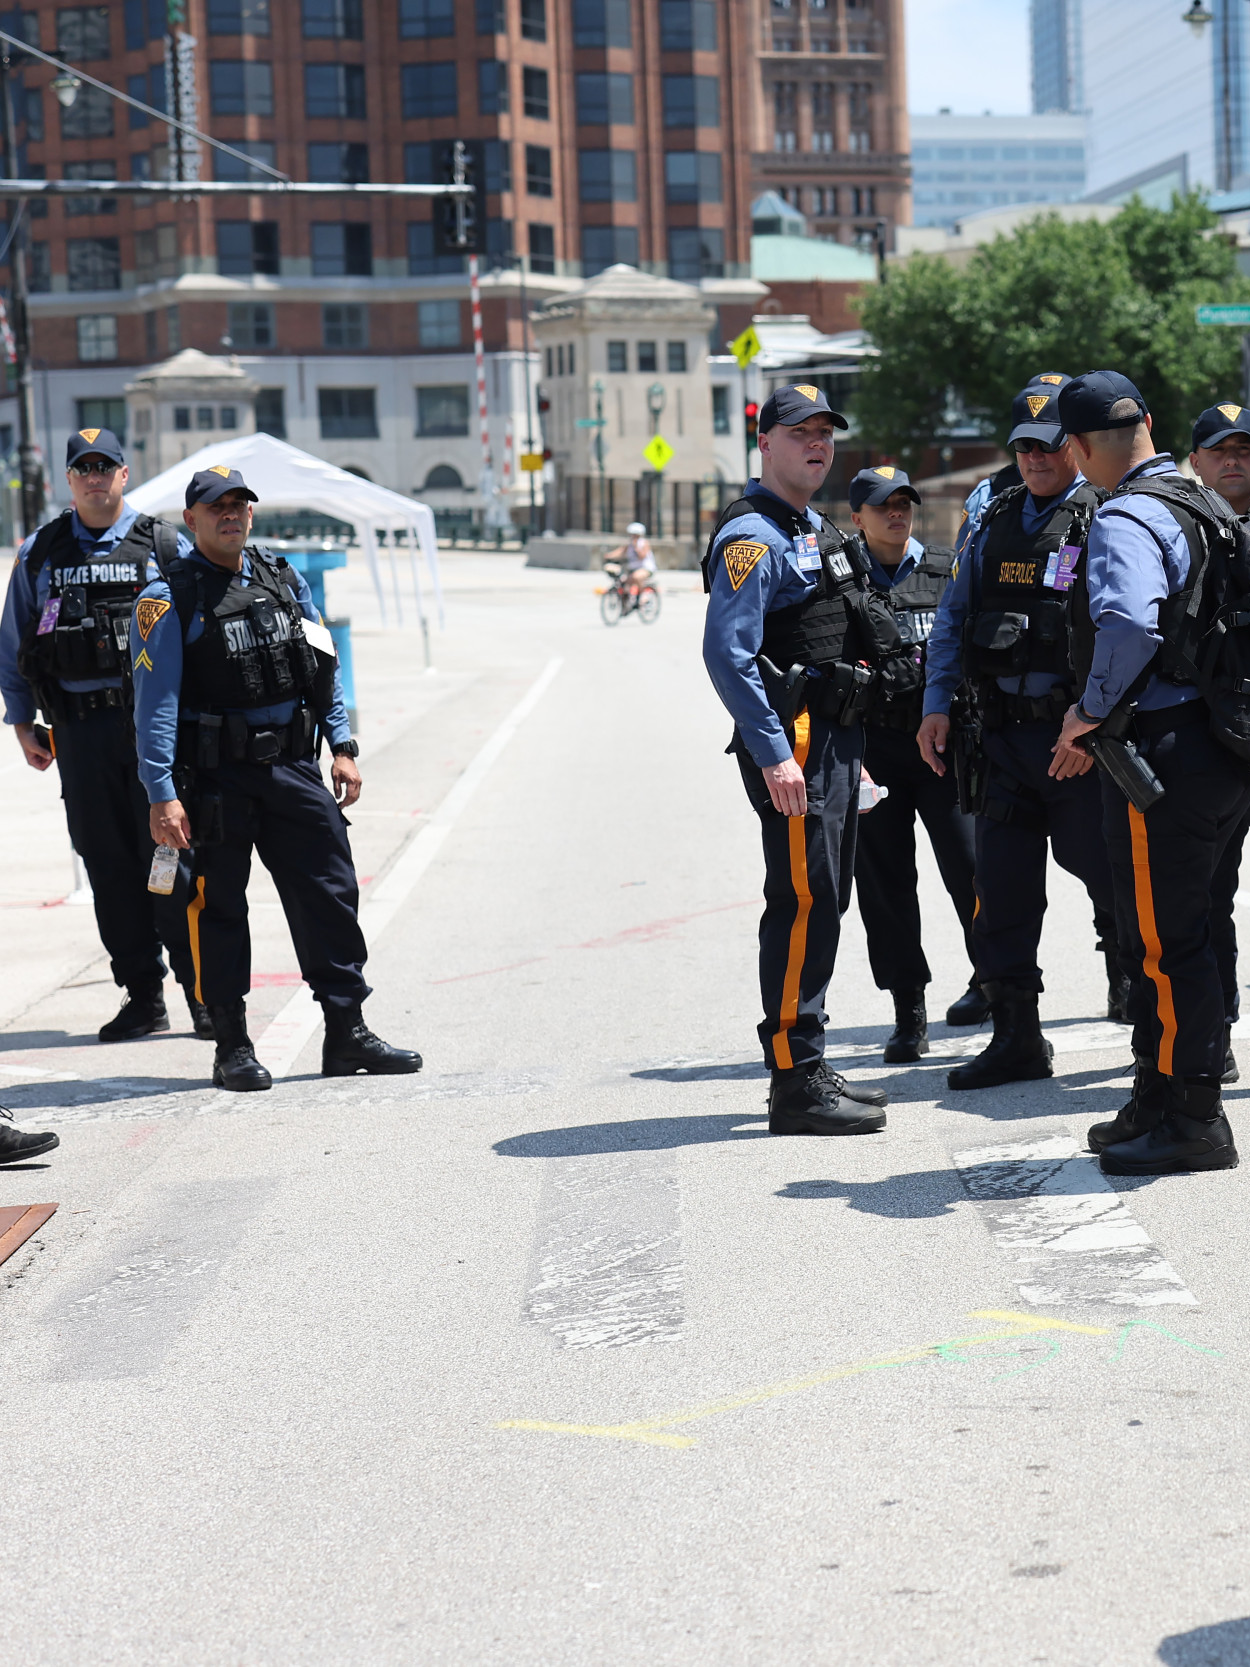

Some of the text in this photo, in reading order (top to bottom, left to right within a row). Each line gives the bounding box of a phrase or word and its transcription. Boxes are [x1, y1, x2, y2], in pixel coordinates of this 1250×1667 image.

[728, 546, 756, 557] STATE
[730, 555, 750, 565] POLICE
[828, 552, 853, 577] STA
[998, 561, 1016, 583] STATE
[1015, 562, 1036, 584] POLICE
[54, 563, 138, 587] STATE POLICE
[139, 603, 159, 612] STATE
